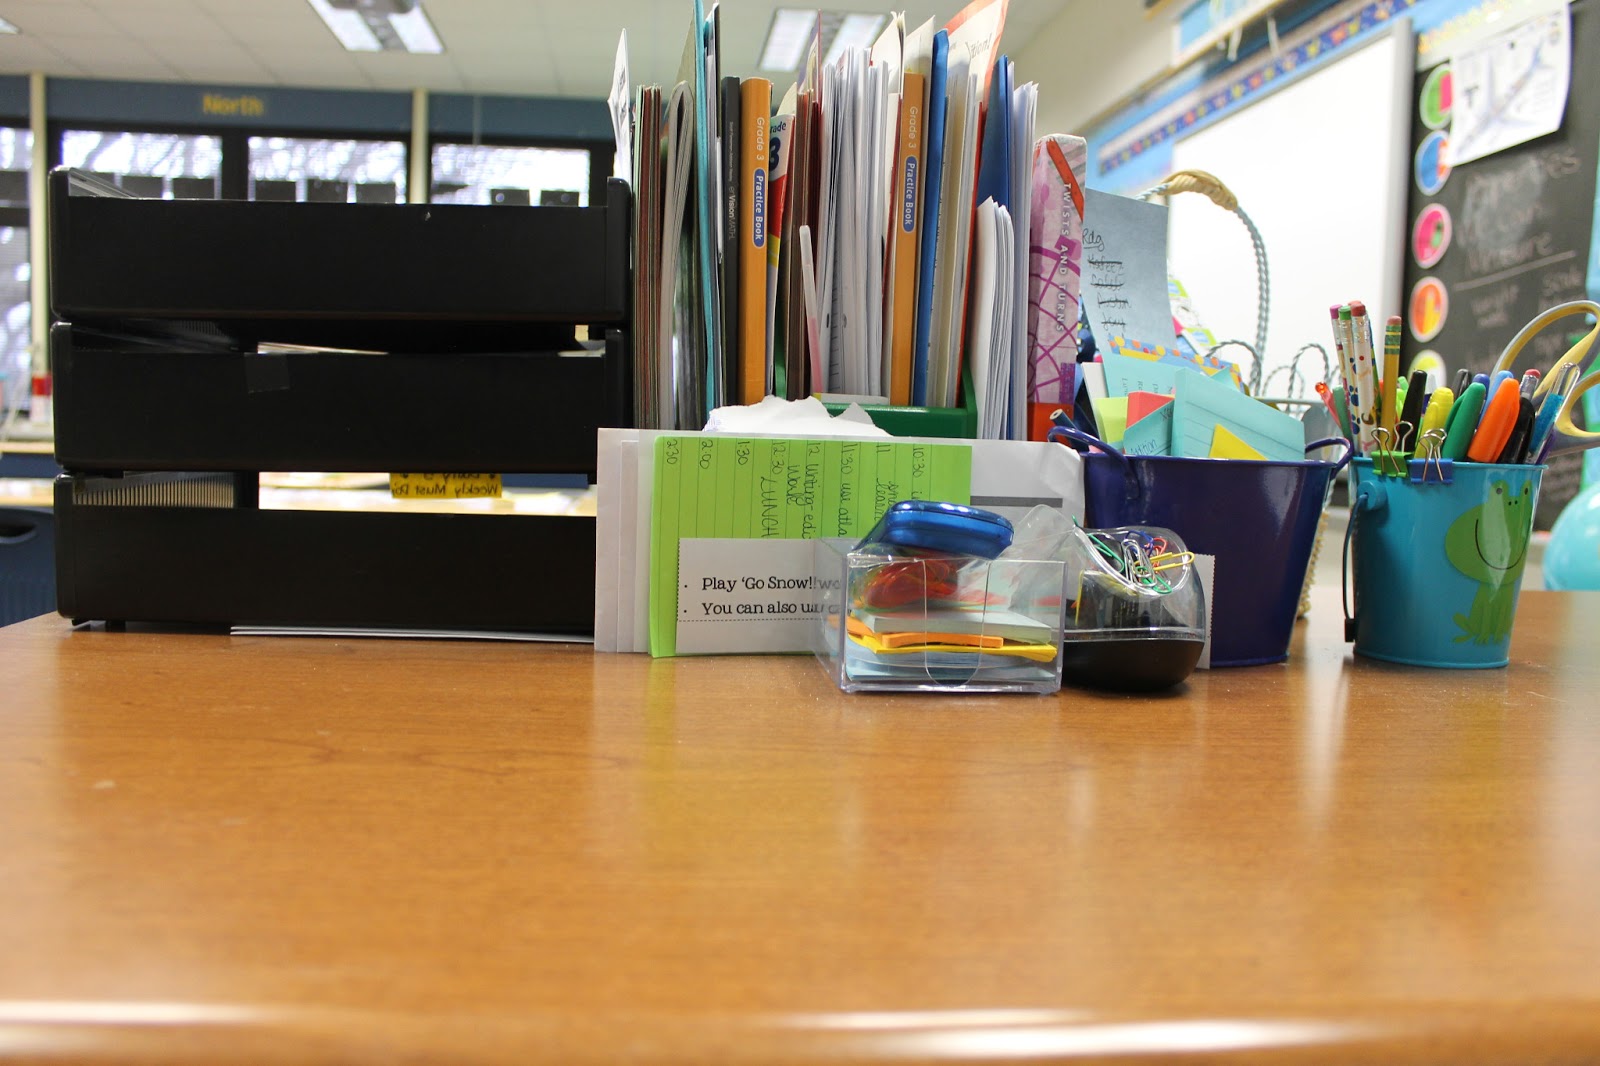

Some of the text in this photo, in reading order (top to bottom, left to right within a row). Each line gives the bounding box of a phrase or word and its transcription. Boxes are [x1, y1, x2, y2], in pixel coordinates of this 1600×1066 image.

[203, 94, 264, 117] North
[756, 117, 765, 151] Grade
[769, 121, 787, 133] rade
[908, 106, 918, 139] Grade
[769, 136, 782, 172] 3
[755, 175, 764, 240] Practice Book
[904, 162, 916, 225] Practice Book
[1056, 182, 1072, 332] TWISTS AND TURNS
[699, 439, 714, 470] 2:00
[736, 440, 751, 466] 1:30
[771, 441, 787, 475] 12:30
[807, 442, 821, 457] 12
[840, 443, 858, 475] 11:30
[875, 443, 891, 454] 11
[912, 446, 926, 478] 10:30
[760, 476, 780, 538] LUNCH
[701, 577, 738, 593] Play
[701, 602, 733, 616] You
[736, 603, 764, 614] can
[767, 601, 797, 614] also
